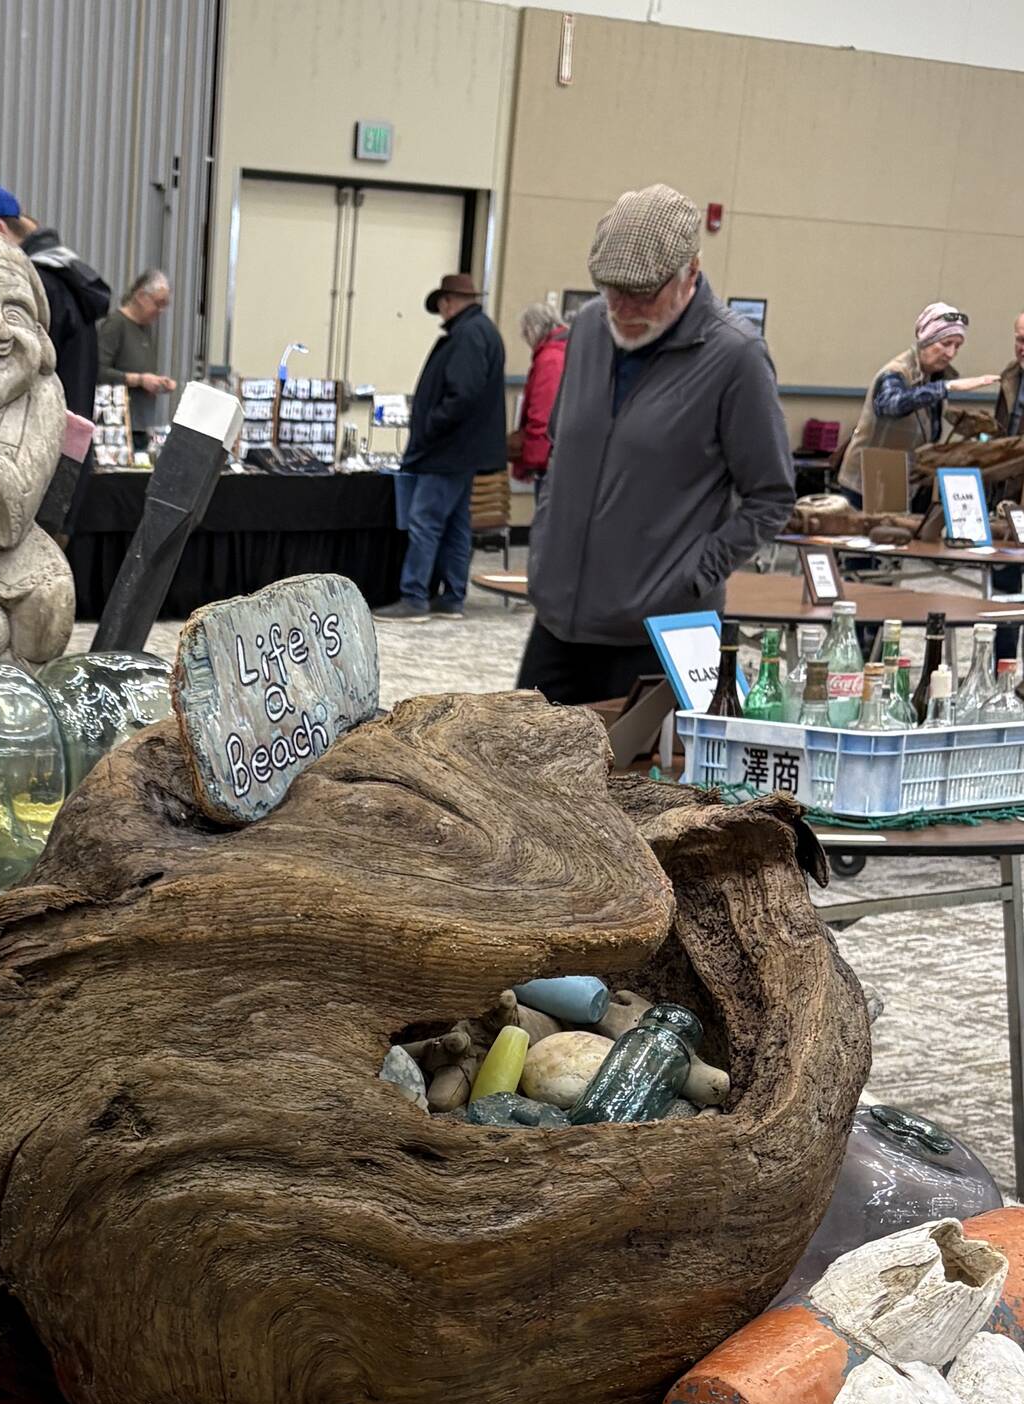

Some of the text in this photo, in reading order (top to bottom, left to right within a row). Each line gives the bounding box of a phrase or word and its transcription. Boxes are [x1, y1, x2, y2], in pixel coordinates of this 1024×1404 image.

[235, 612, 342, 687] Life's
[264, 682, 295, 723] a
[226, 711, 328, 797] Beach
